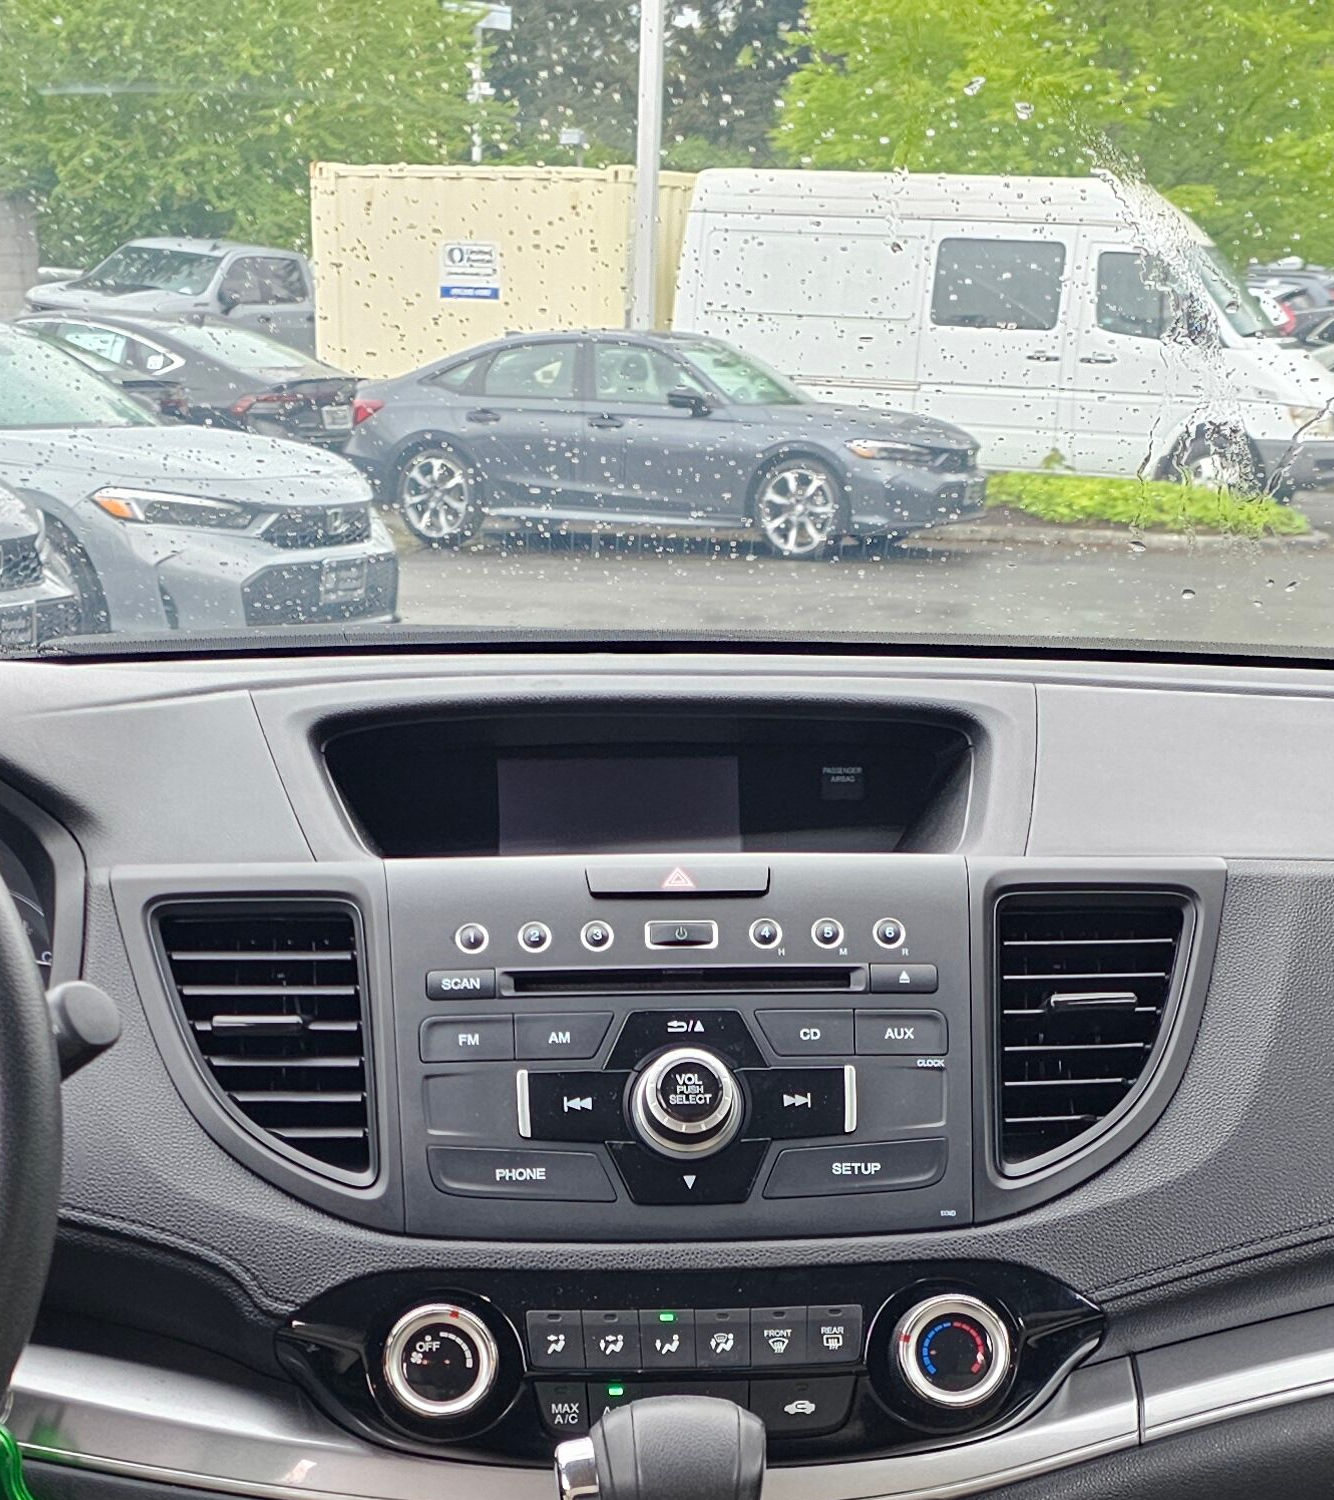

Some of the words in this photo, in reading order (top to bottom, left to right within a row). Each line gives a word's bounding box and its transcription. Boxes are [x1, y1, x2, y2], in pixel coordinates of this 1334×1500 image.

[530, 929, 540, 941] 2
[593, 929, 603, 941] 3
[760, 927, 771, 938] 4
[823, 927, 833, 938] 5
[885, 926, 895, 938] 6
[441, 976, 481, 991] SCAN
[458, 1033, 480, 1046] FM
[548, 1031, 571, 1044] AM
[799, 1028, 821, 1041] CD
[884, 1027, 915, 1040] AUX
[916, 1059, 946, 1068] CLOCK
[675, 1073, 703, 1085] VOL
[676, 1085, 704, 1094] PUSH
[669, 1094, 713, 1105] SELECT
[495, 1167, 546, 1181] PHONE
[832, 1162, 882, 1175] SETUP
[763, 1328, 792, 1338] FRONT
[820, 1326, 844, 1335] REAR
[416, 1341, 441, 1352] OFF
[551, 1403, 580, 1414] MAX
[554, 1414, 579, 1425] A/C
